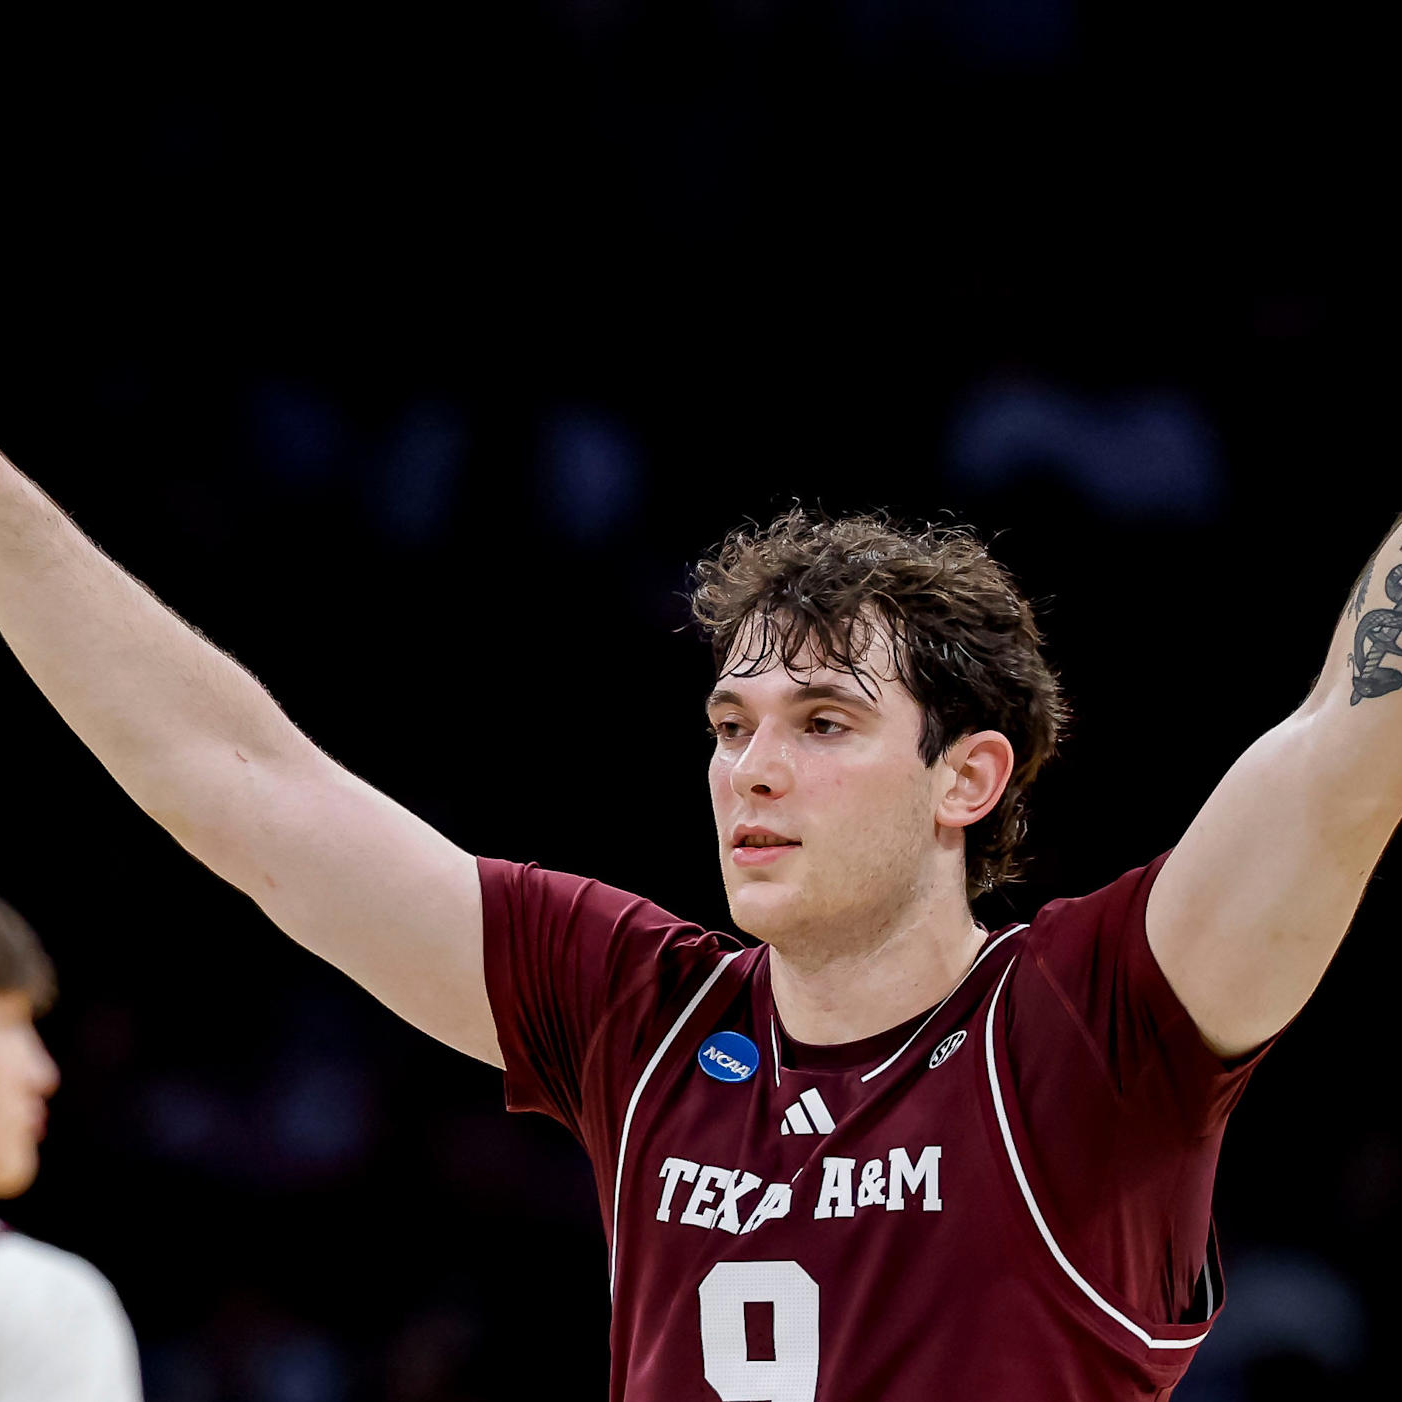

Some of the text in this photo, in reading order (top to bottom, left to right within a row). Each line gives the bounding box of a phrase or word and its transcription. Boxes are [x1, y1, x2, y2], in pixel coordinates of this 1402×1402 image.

[703, 1046, 750, 1078] NCAA
[656, 1146, 942, 1235] TEXA A&M
